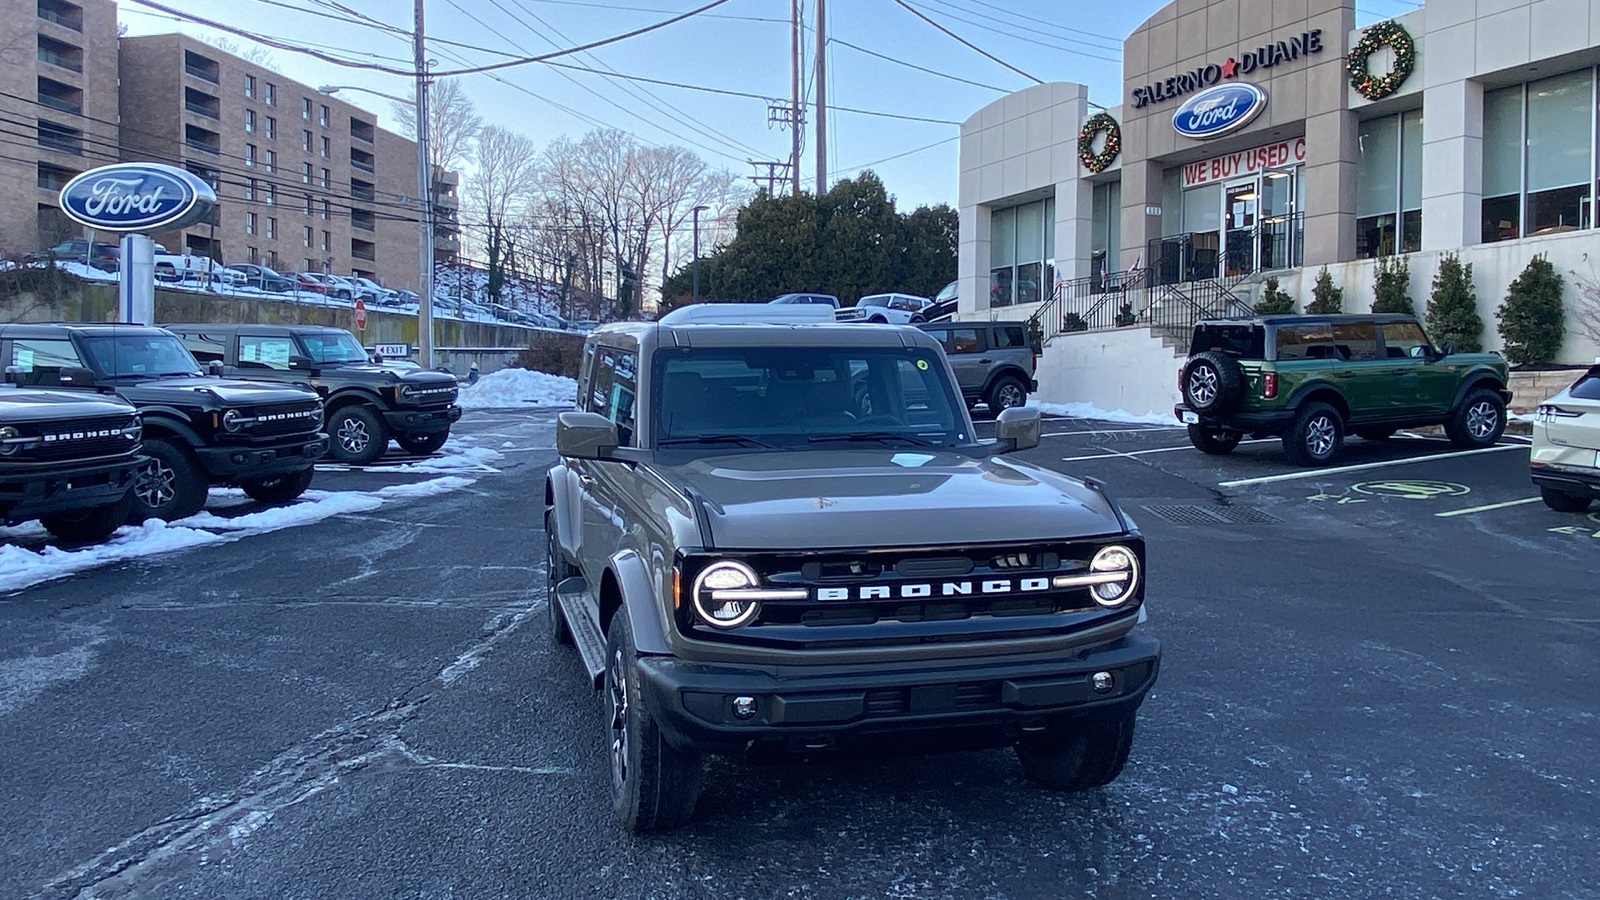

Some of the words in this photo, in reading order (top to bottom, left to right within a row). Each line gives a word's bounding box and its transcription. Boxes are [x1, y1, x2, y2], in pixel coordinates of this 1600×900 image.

[1130, 63, 1222, 109] SALERNO
[1240, 28, 1324, 74] DUANE
[1188, 95, 1239, 130] Ford
[1184, 162, 1207, 185] WE
[1211, 153, 1242, 180] BUY
[1246, 142, 1289, 171] USED
[85, 178, 165, 216] Ford
[386, 346, 403, 354] EXIT
[257, 411, 311, 421] BRONCO
[44, 429, 121, 442] BRONCO
[817, 577, 1049, 601] BRONCO
